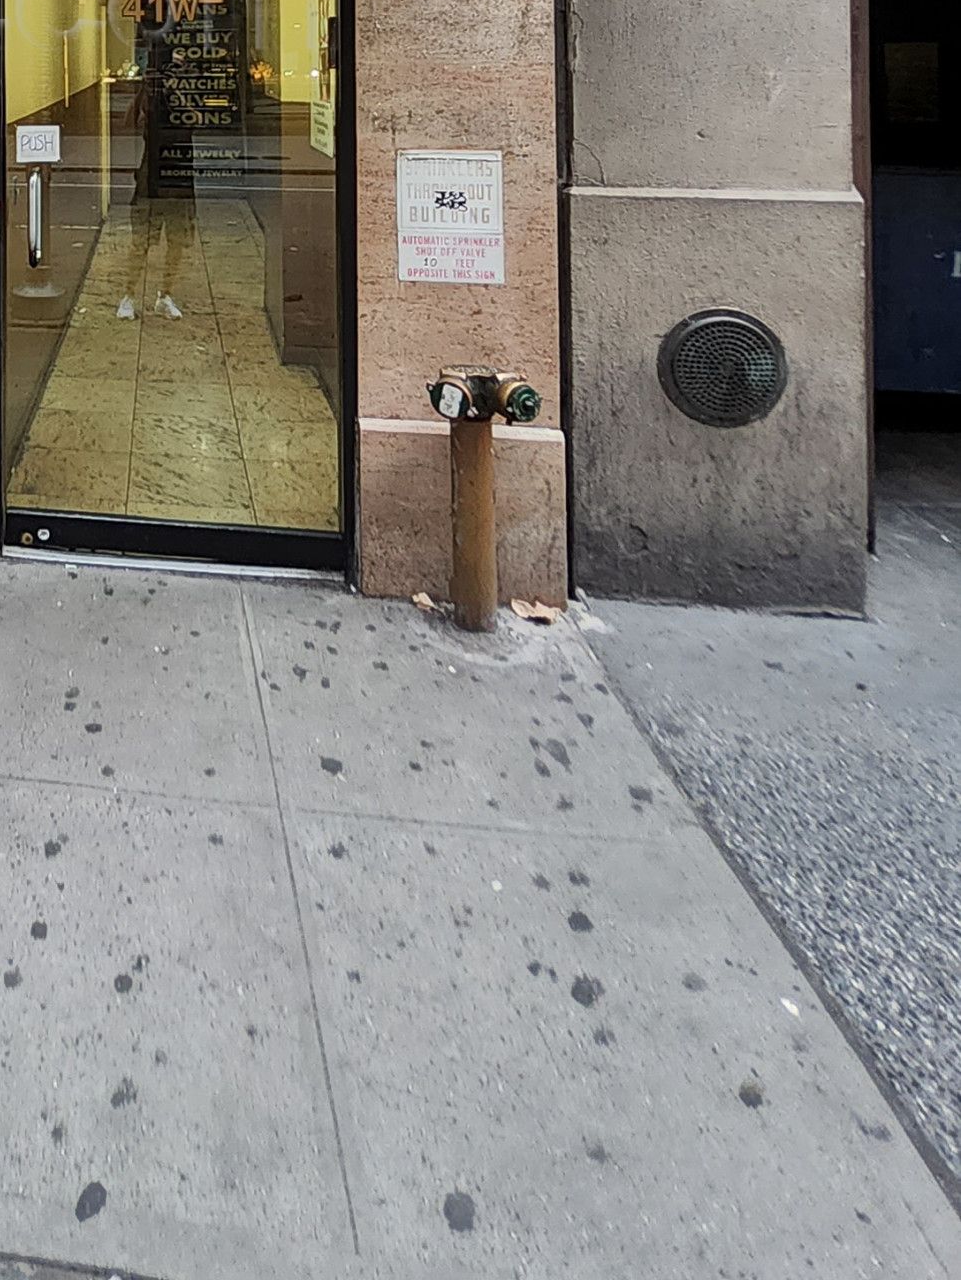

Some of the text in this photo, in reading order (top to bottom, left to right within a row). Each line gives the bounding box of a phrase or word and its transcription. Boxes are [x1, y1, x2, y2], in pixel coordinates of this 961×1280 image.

[163, 30, 232, 44] WE BUY
[21, 133, 55, 152] PUSH
[402, 235, 500, 247] AUTOMATIC SPRINKLER
[415, 247, 487, 258] SHUT OFF VALVE
[455, 258, 476, 269] FEET
[407, 268, 496, 280] OPPOSITE THIS SIGN
